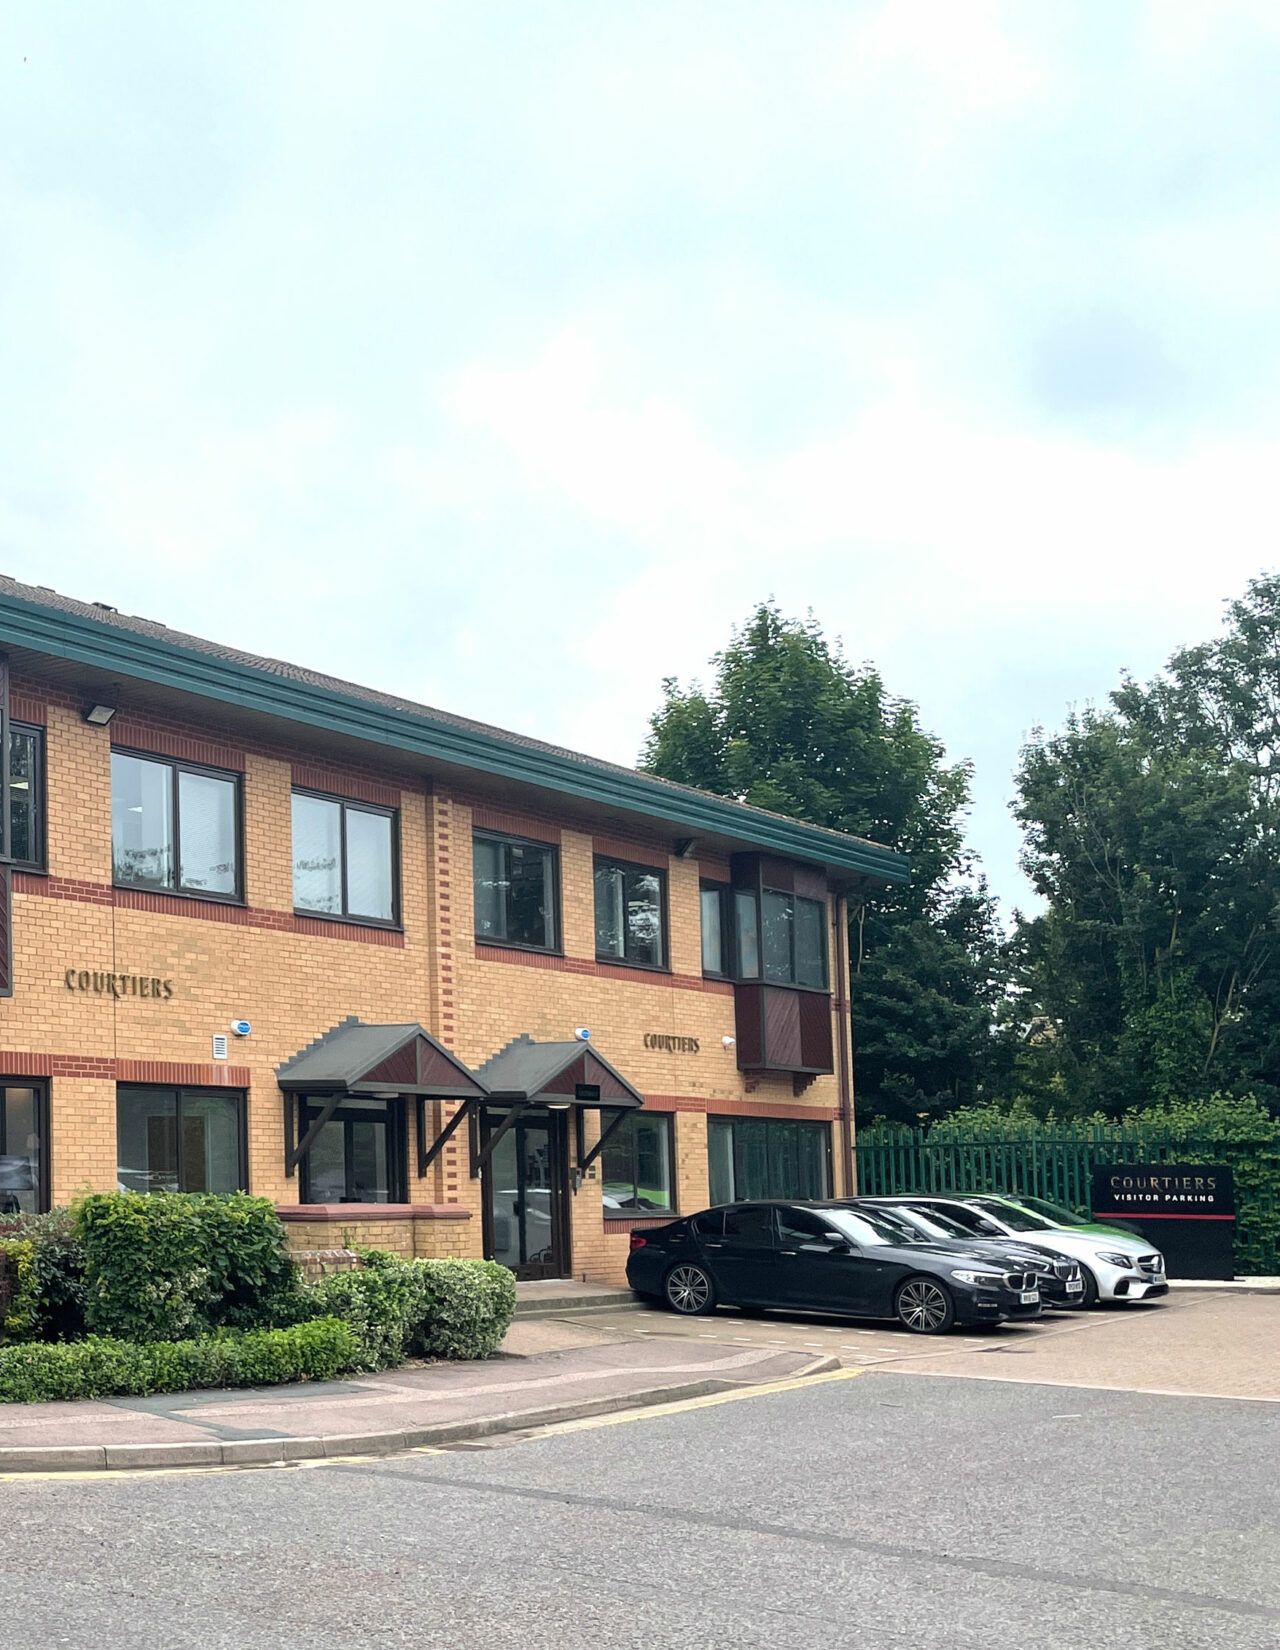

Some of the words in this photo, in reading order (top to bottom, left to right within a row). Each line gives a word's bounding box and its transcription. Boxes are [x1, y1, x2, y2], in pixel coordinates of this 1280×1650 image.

[65, 969, 173, 999] COURTIERS
[643, 1033, 700, 1054] COURTIERS
[1110, 1176, 1216, 1192] COURTIERS
[1165, 1194, 1215, 1202] PARKING
